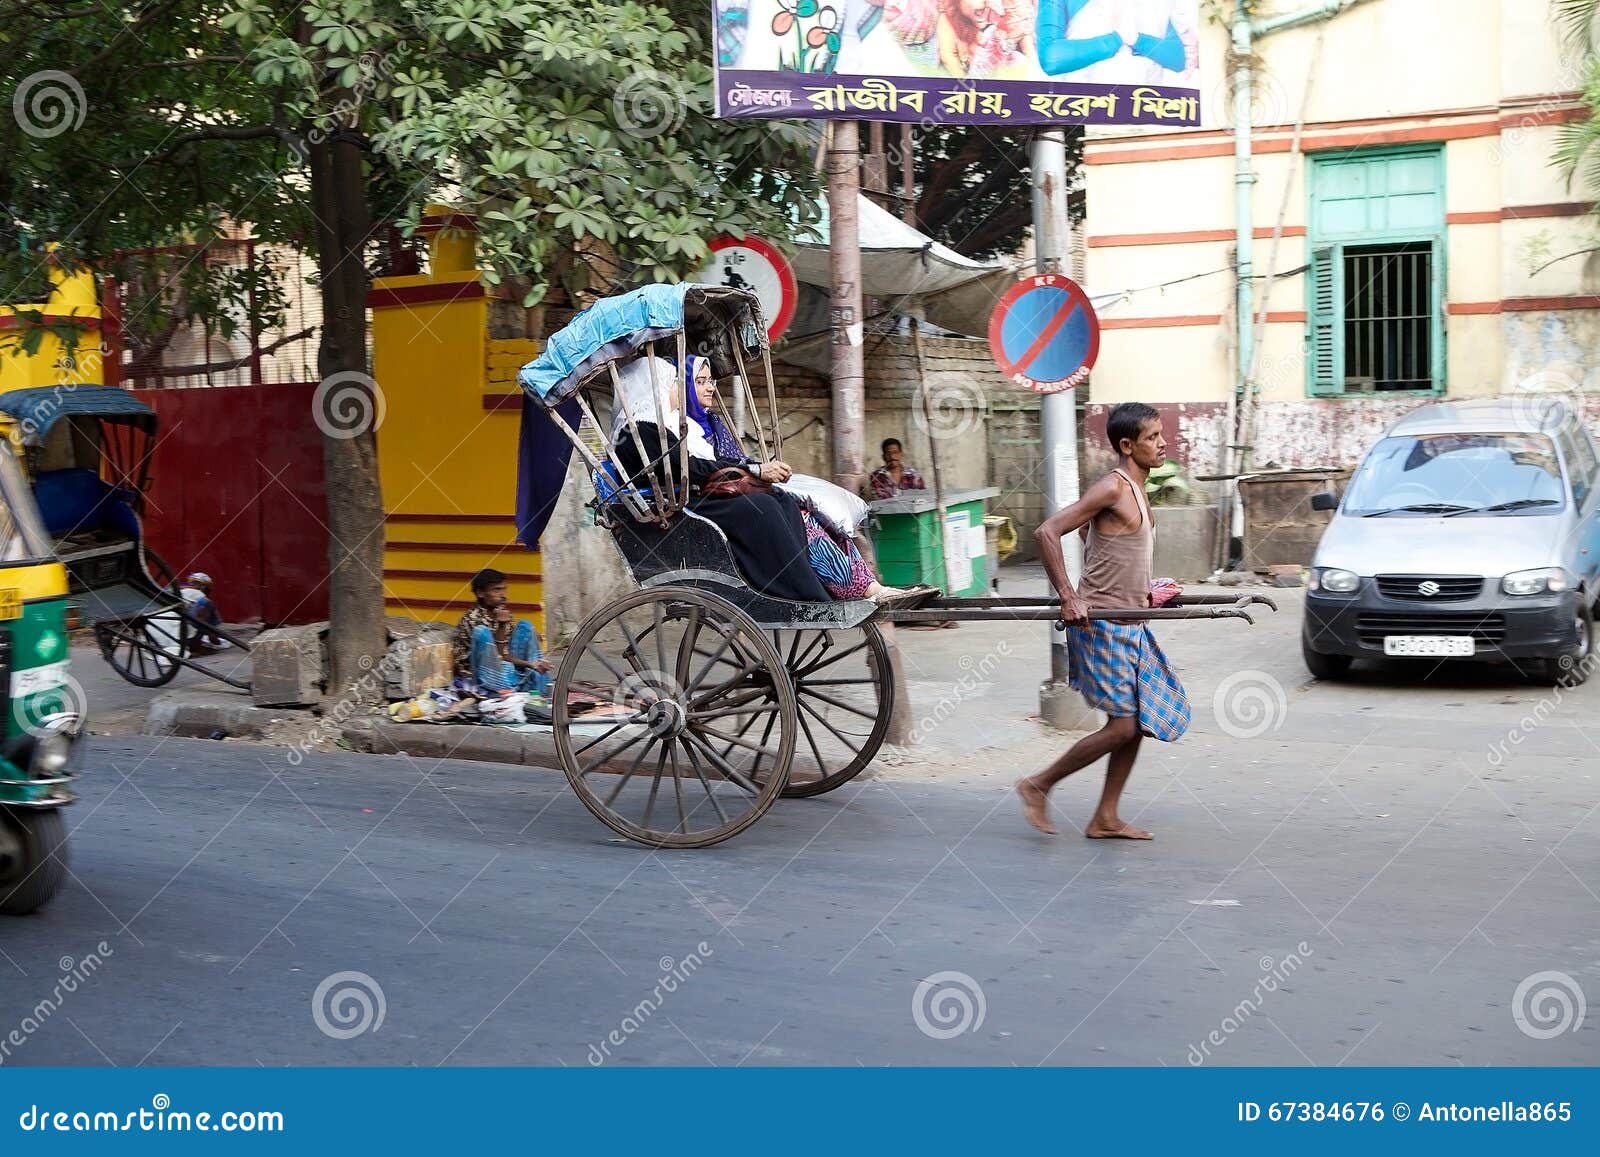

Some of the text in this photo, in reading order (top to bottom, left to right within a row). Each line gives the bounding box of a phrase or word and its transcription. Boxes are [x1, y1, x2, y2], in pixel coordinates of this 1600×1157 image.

[801, 78, 929, 113] রাজীব
[937, 88, 1013, 118] রায়,
[1027, 92, 1120, 119] হরেশ
[1130, 87, 1199, 121] মিশ্রা
[1012, 365, 1090, 392] NO PARKING
